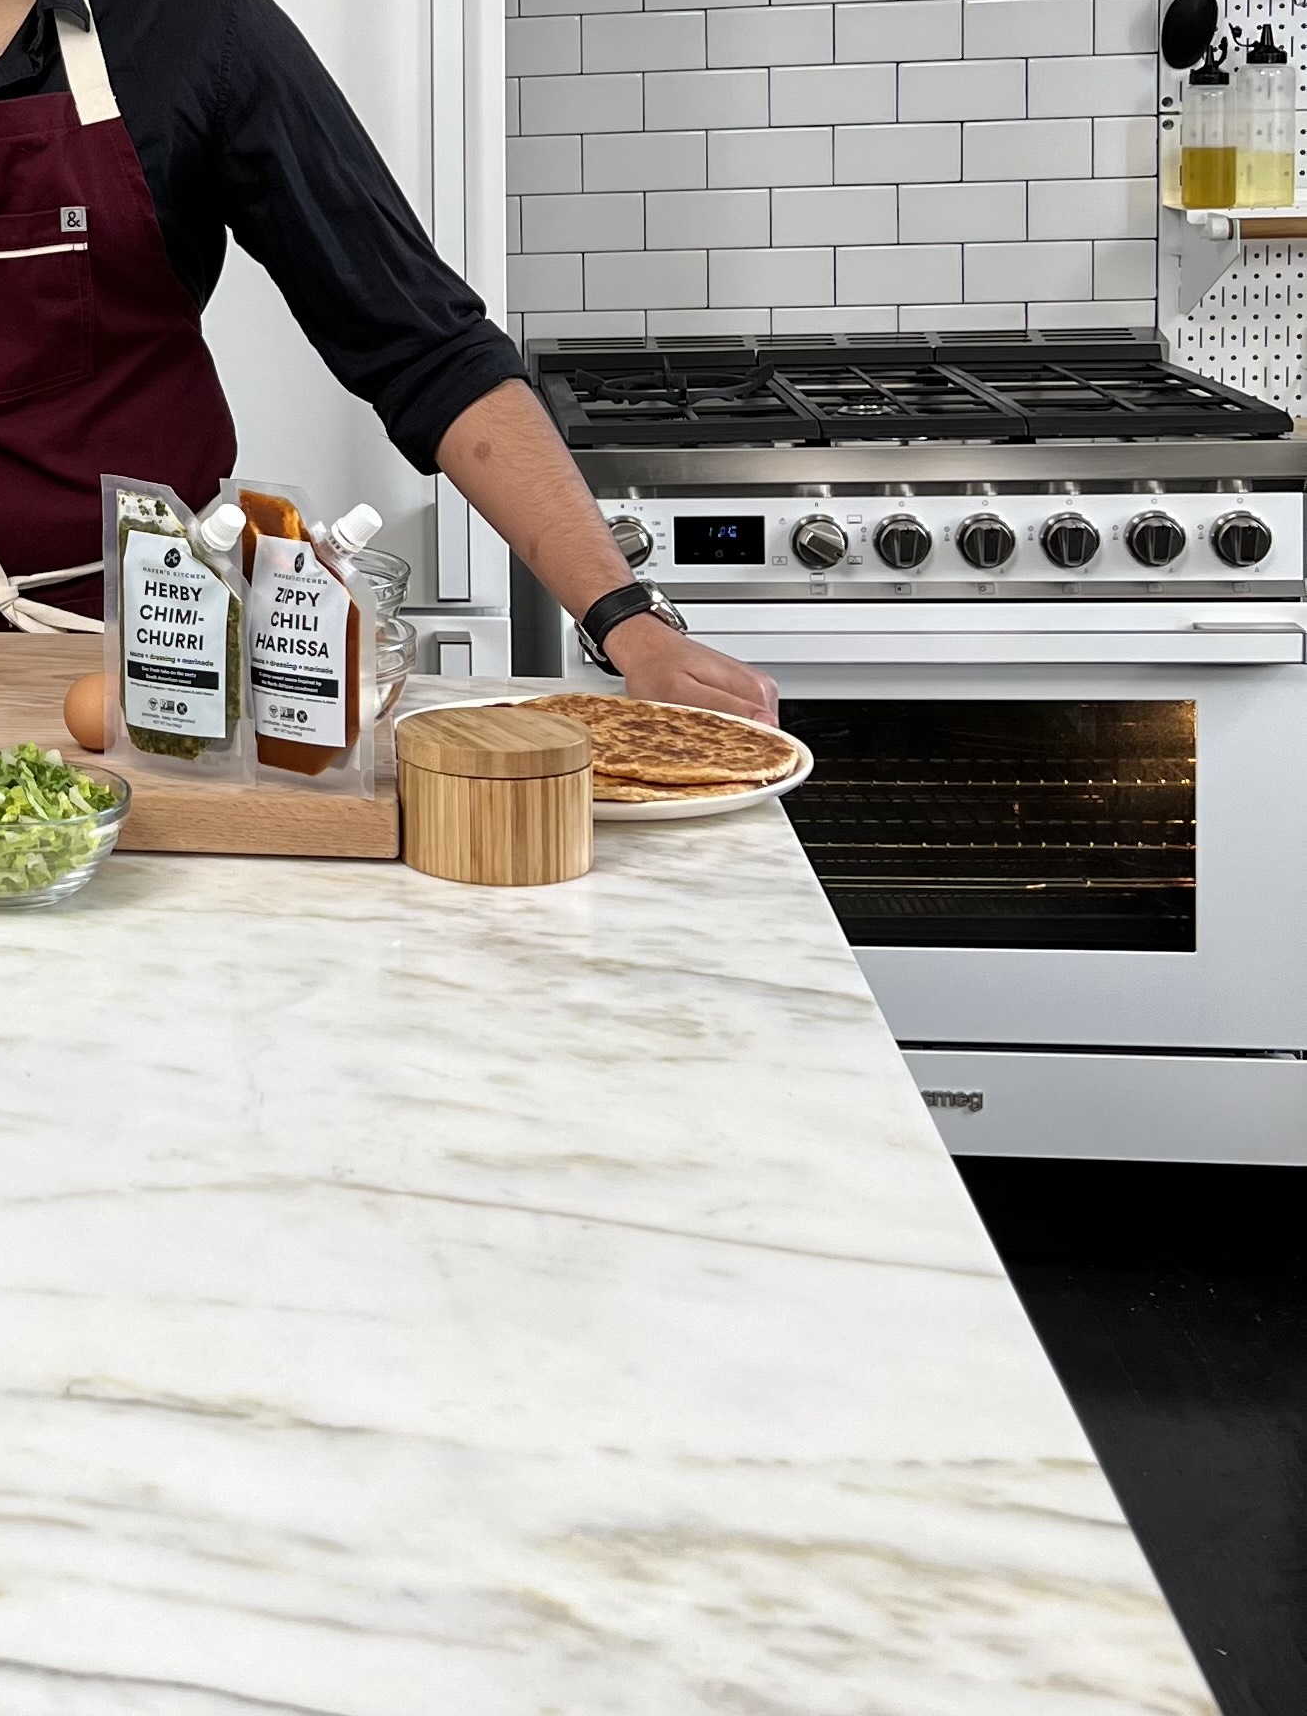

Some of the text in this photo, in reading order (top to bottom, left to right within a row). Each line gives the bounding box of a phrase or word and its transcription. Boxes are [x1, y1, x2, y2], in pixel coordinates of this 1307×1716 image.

[144, 579, 203, 602] HERBY
[274, 586, 321, 608] ZIPPY
[139, 604, 205, 626] CHIMI-
[270, 610, 319, 632] CHILI
[136, 627, 204, 651] CHURRI
[255, 632, 330, 659] HARISSA
